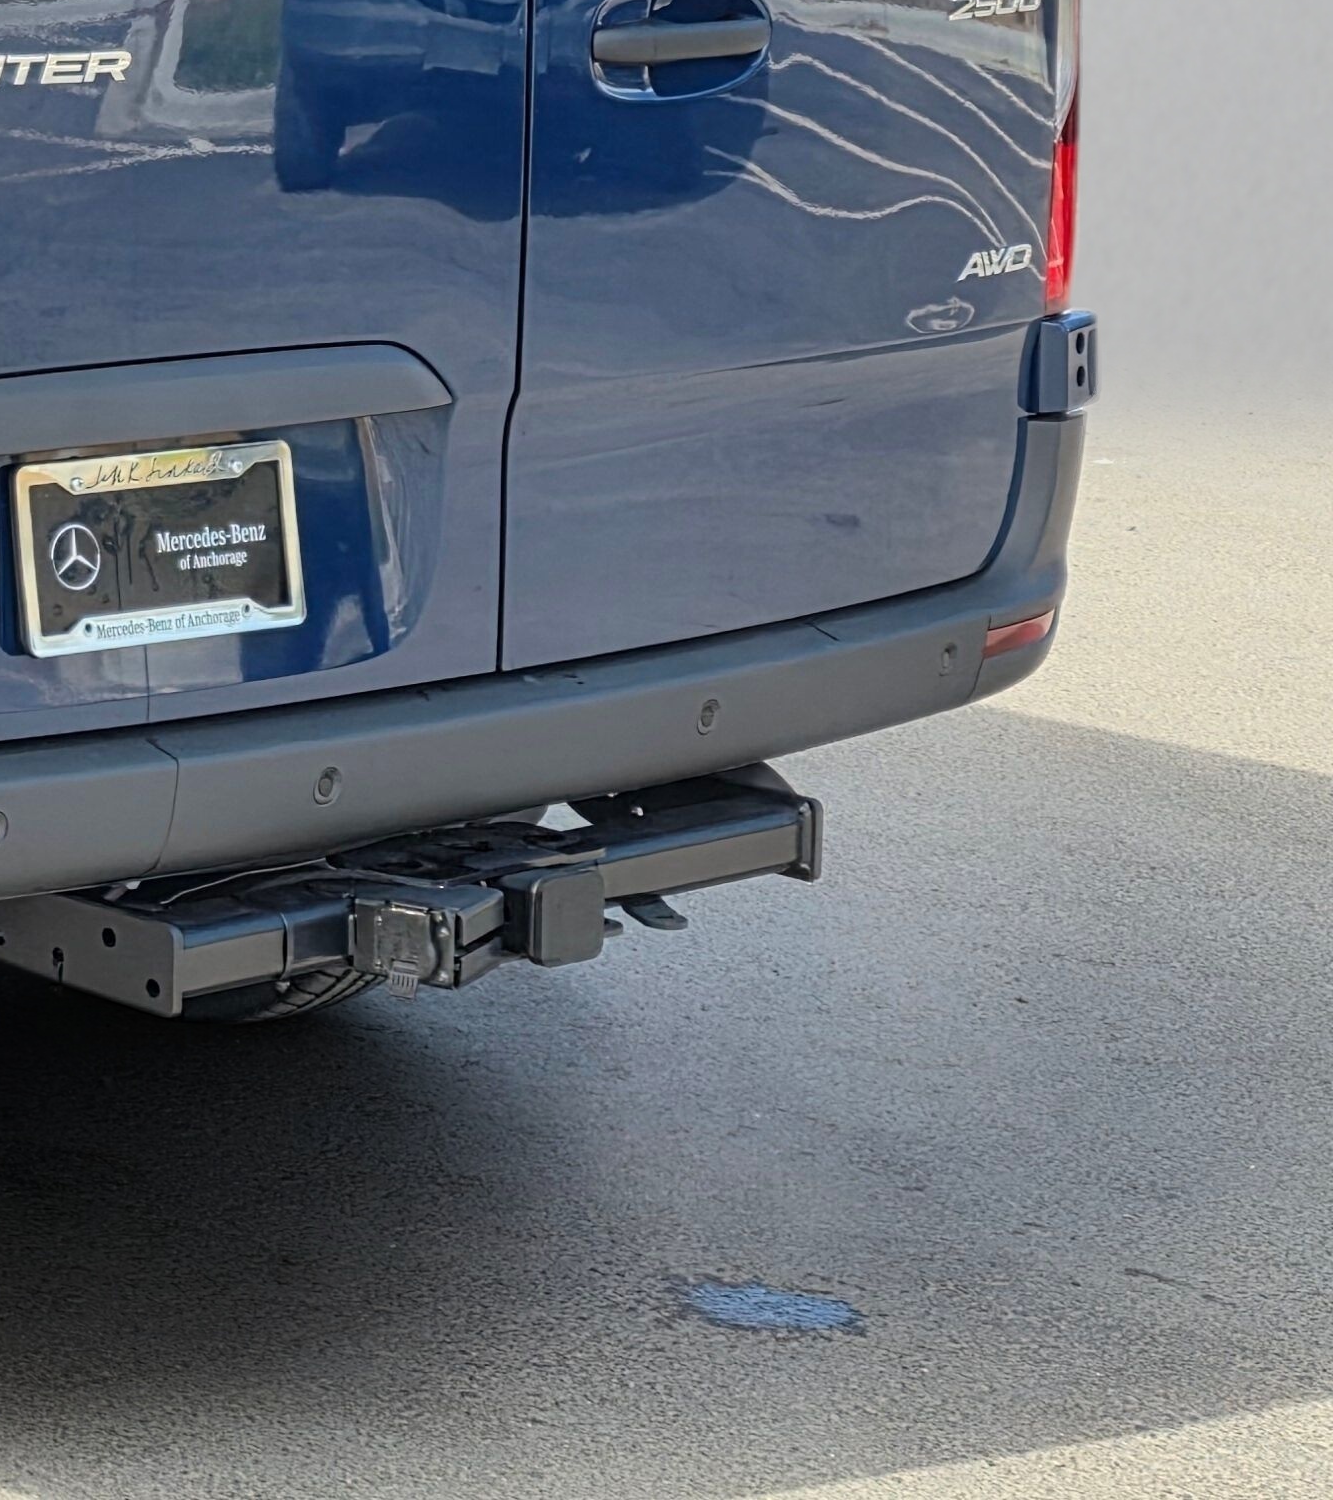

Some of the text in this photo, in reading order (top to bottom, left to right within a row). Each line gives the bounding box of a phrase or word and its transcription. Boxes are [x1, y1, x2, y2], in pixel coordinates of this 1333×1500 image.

[956, 243, 1032, 282] AWD
[157, 523, 267, 553] Mercedes-Benz
[180, 550, 248, 570] of Anchorage
[96, 609, 241, 639] Mercedes-Benz of Anchorage
